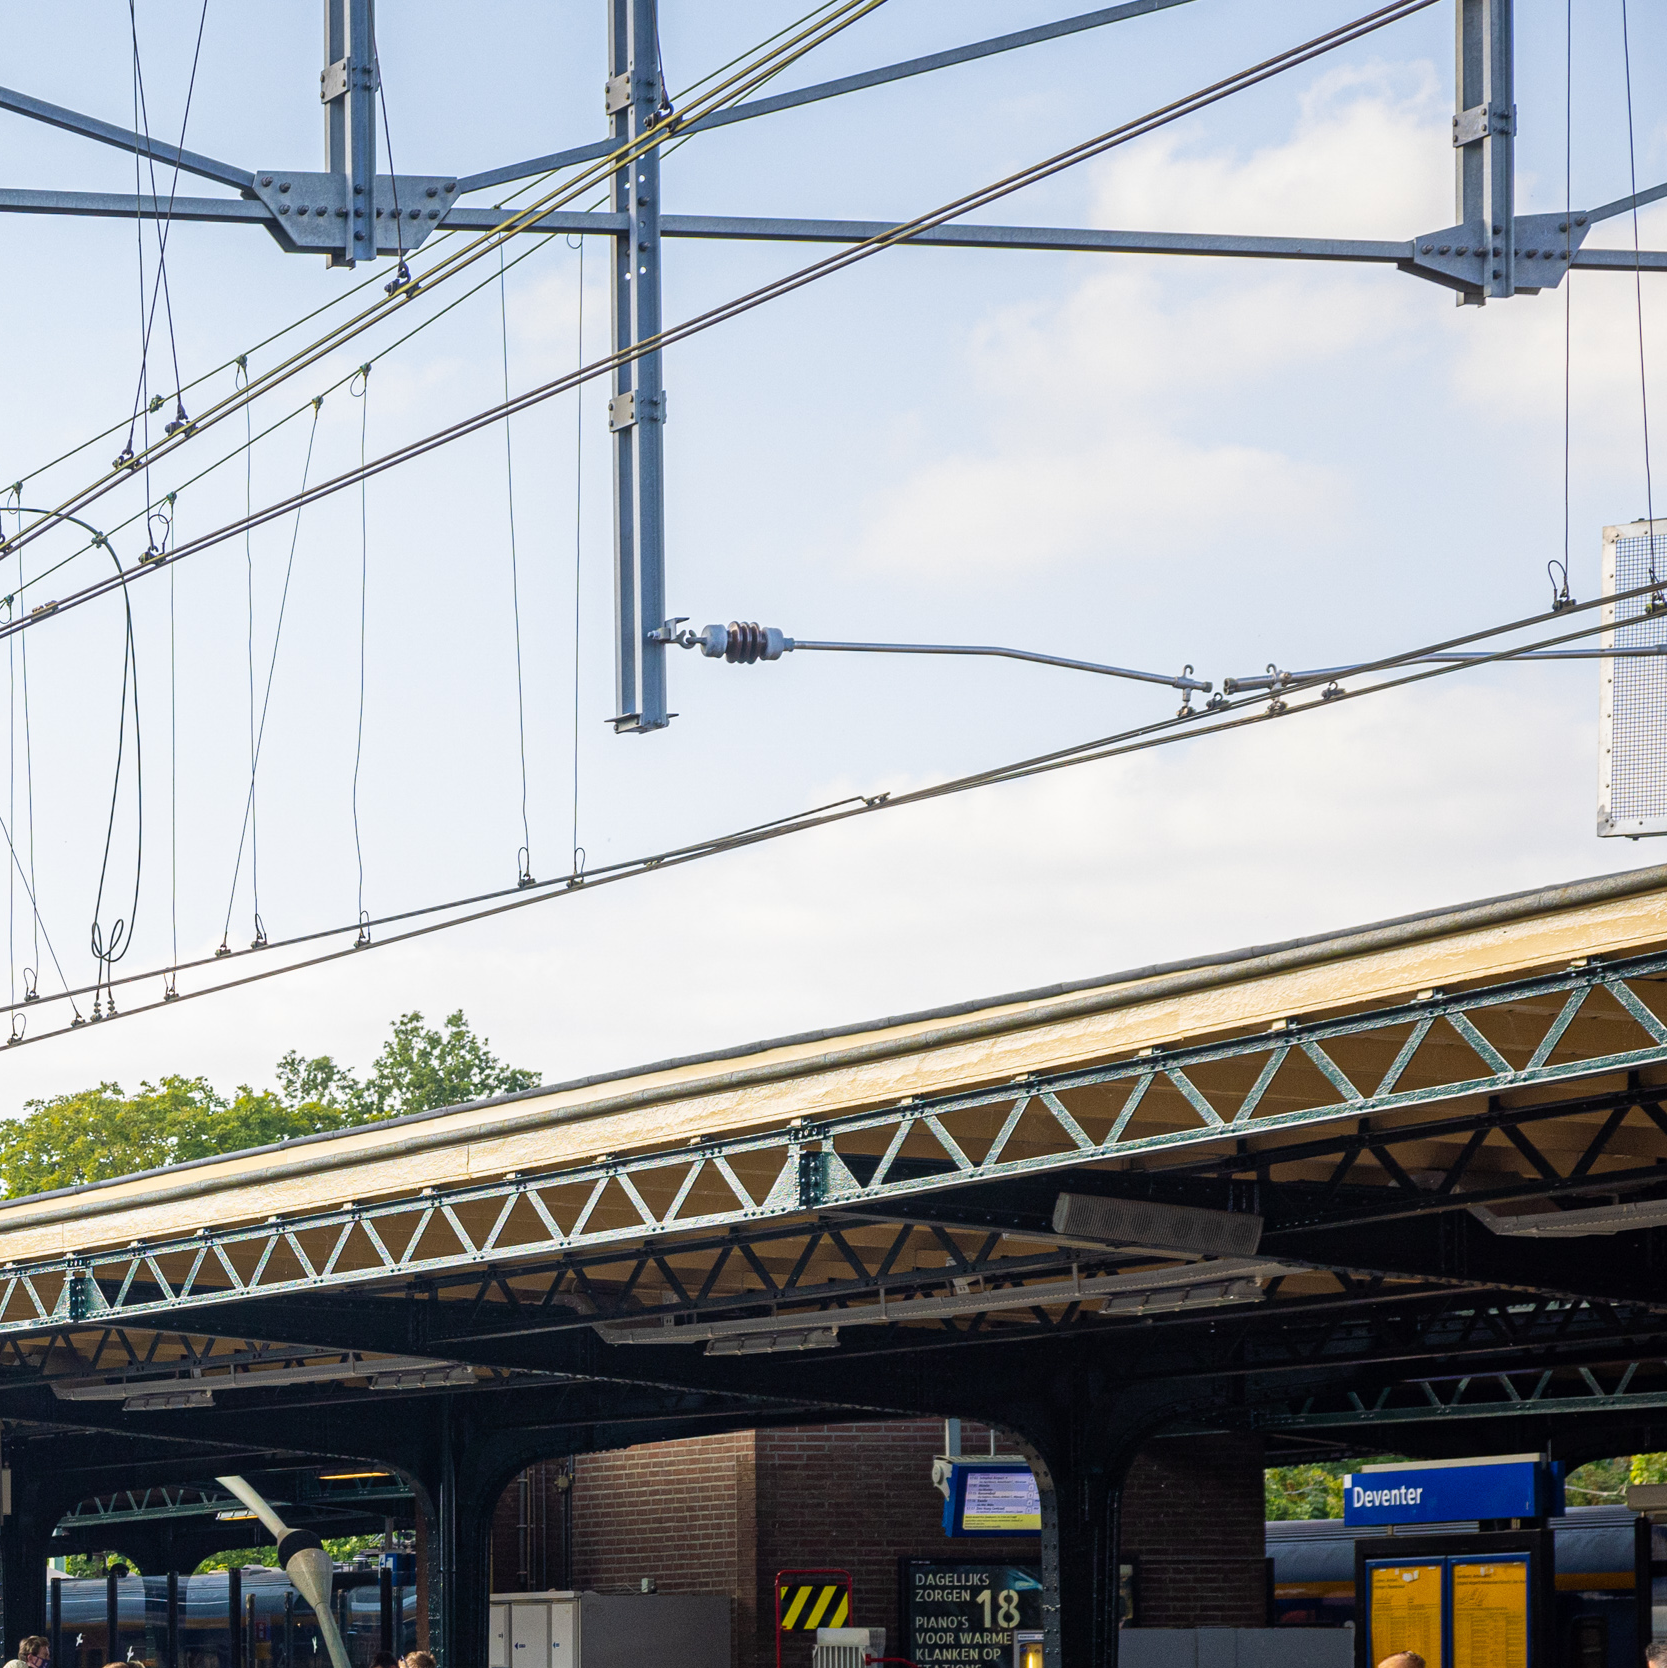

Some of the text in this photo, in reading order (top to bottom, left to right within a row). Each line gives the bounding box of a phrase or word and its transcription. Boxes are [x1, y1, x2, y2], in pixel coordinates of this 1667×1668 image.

[1353, 1485, 1423, 1508] Deventer
[915, 1573, 990, 1586] DAGELIJKS
[915, 1589, 970, 1602] ZORGEN
[976, 1589, 1021, 1628] 18
[915, 1616, 969, 1629] PIANO'S
[915, 1632, 1012, 1644] VOOR WARME
[915, 1648, 1001, 1660] KLANKEN OP
